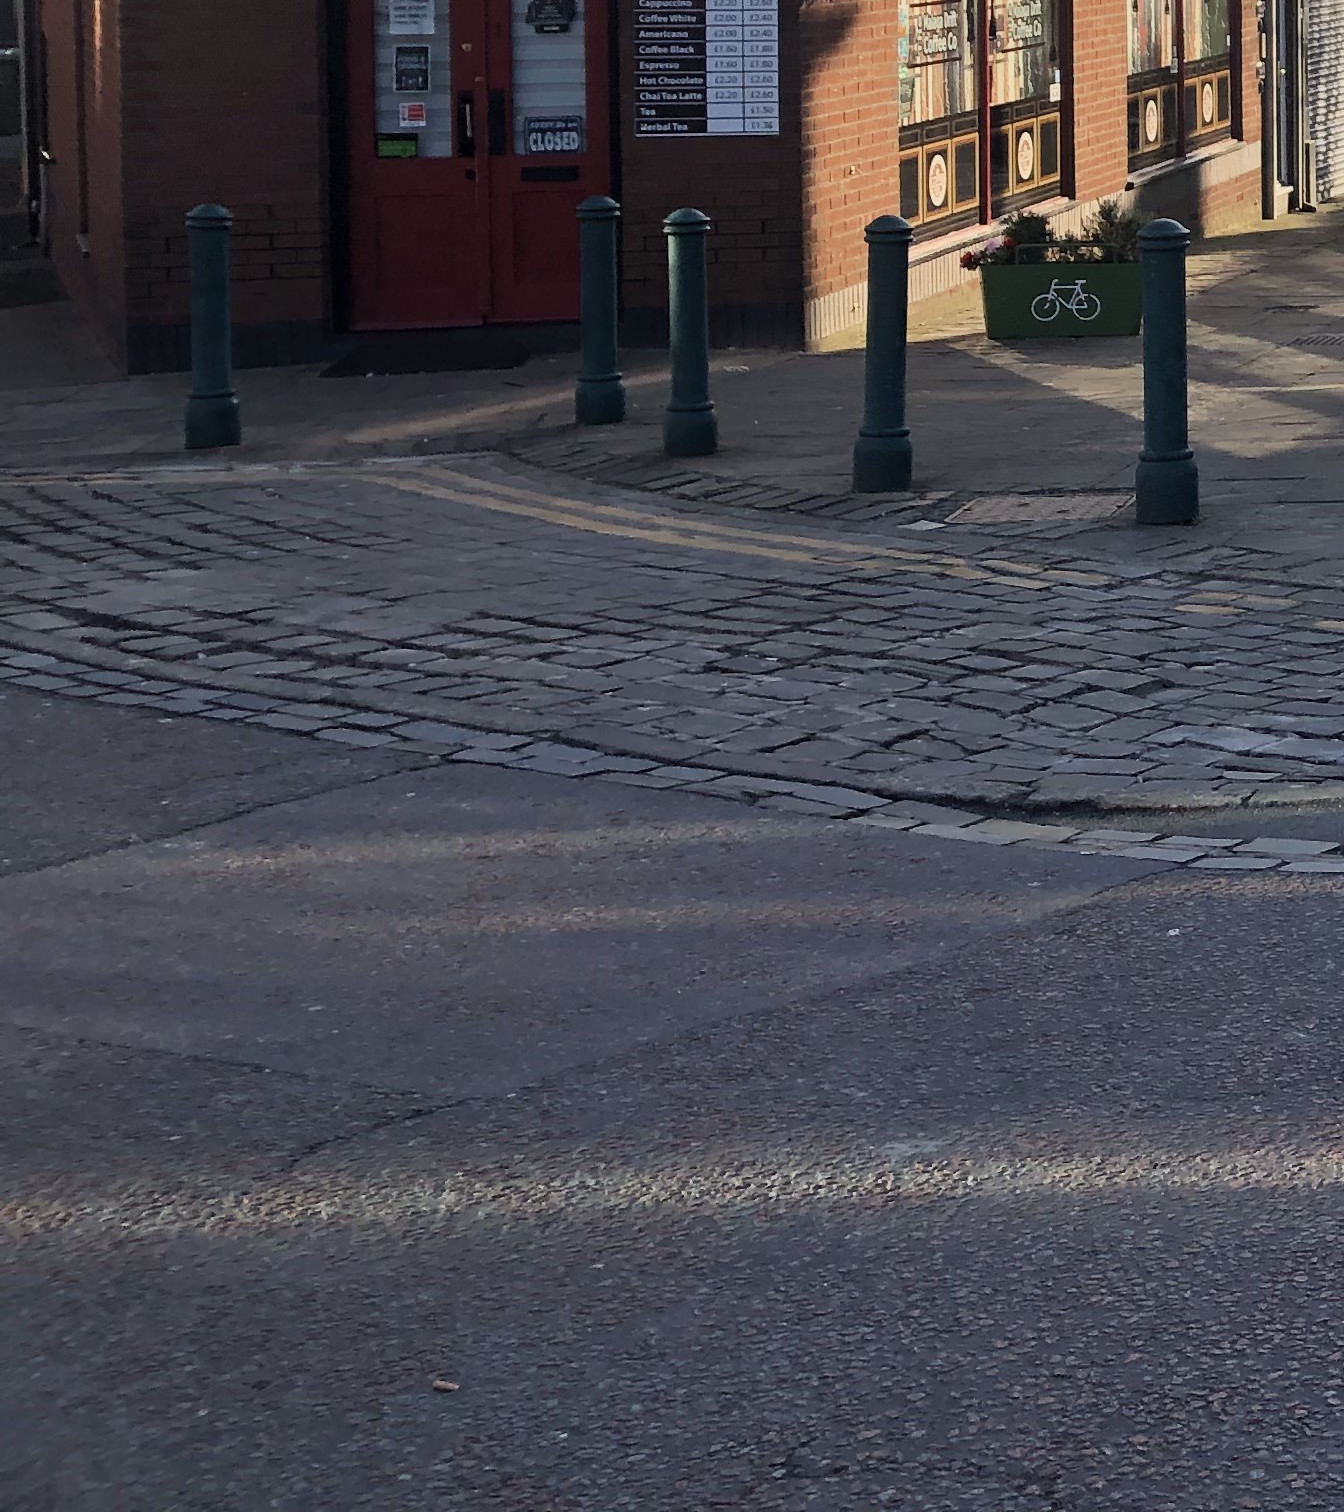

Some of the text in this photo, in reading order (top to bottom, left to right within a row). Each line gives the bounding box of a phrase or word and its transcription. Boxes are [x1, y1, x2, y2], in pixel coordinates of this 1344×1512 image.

[639, 0, 693, 8] Cappuccino
[639, 14, 669, 23] Coffee
[639, 30, 689, 38] Americano
[639, 45, 668, 53] Coffee
[658, 77, 704, 85] Chocolate
[640, 108, 656, 116] Tea
[673, 123, 688, 131] Tea
[530, 131, 578, 152] CLOSED
